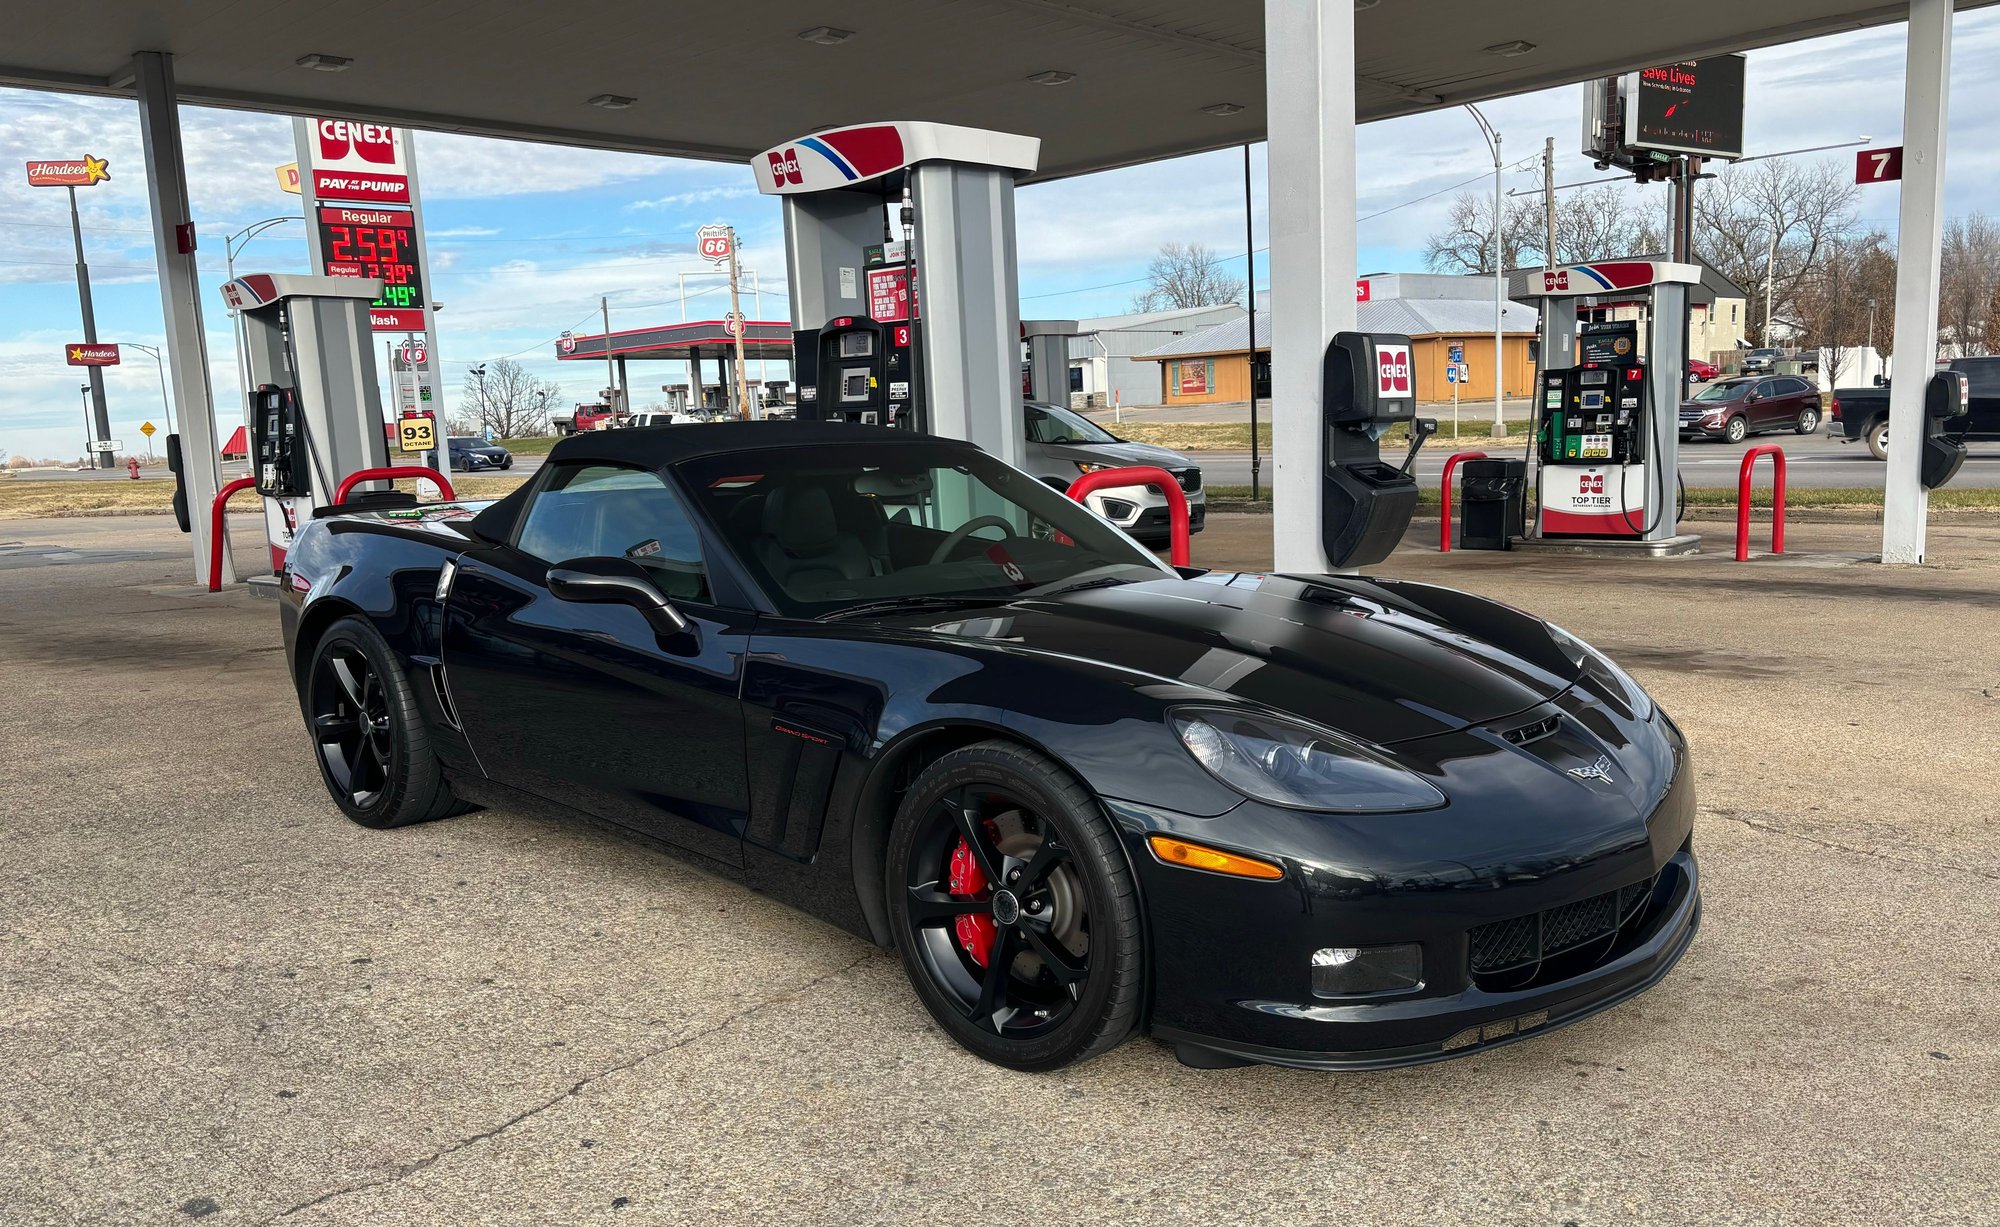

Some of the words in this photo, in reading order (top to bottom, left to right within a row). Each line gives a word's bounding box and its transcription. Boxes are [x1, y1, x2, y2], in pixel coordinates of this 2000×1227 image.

[1643, 67, 1667, 81] Save
[1670, 68, 1696, 86] Lives
[320, 120, 392, 145] CENEX
[29, 163, 87, 177] Hardee's
[772, 160, 799, 175] CENEX
[1870, 152, 1891, 178] 7
[320, 178, 349, 189] PAY
[361, 182, 405, 192] PUMP
[342, 210, 392, 224] Regular
[186, 225, 193, 247] 1
[703, 230, 727, 238] PHILLIPS
[705, 240, 726, 253] 66
[1545, 277, 1567, 285] CENEX
[899, 329, 908, 344] 3
[84, 350, 114, 358] Hardee's
[1381, 364, 1407, 378] CENEX
[1631, 370, 1638, 378] 7
[403, 426, 431, 440] 93
[1581, 480, 1602, 488] CENEX
[1591, 496, 1611, 504] TIER
[775, 725, 801, 737] GRAND
[801, 733, 829, 744] SPORT
